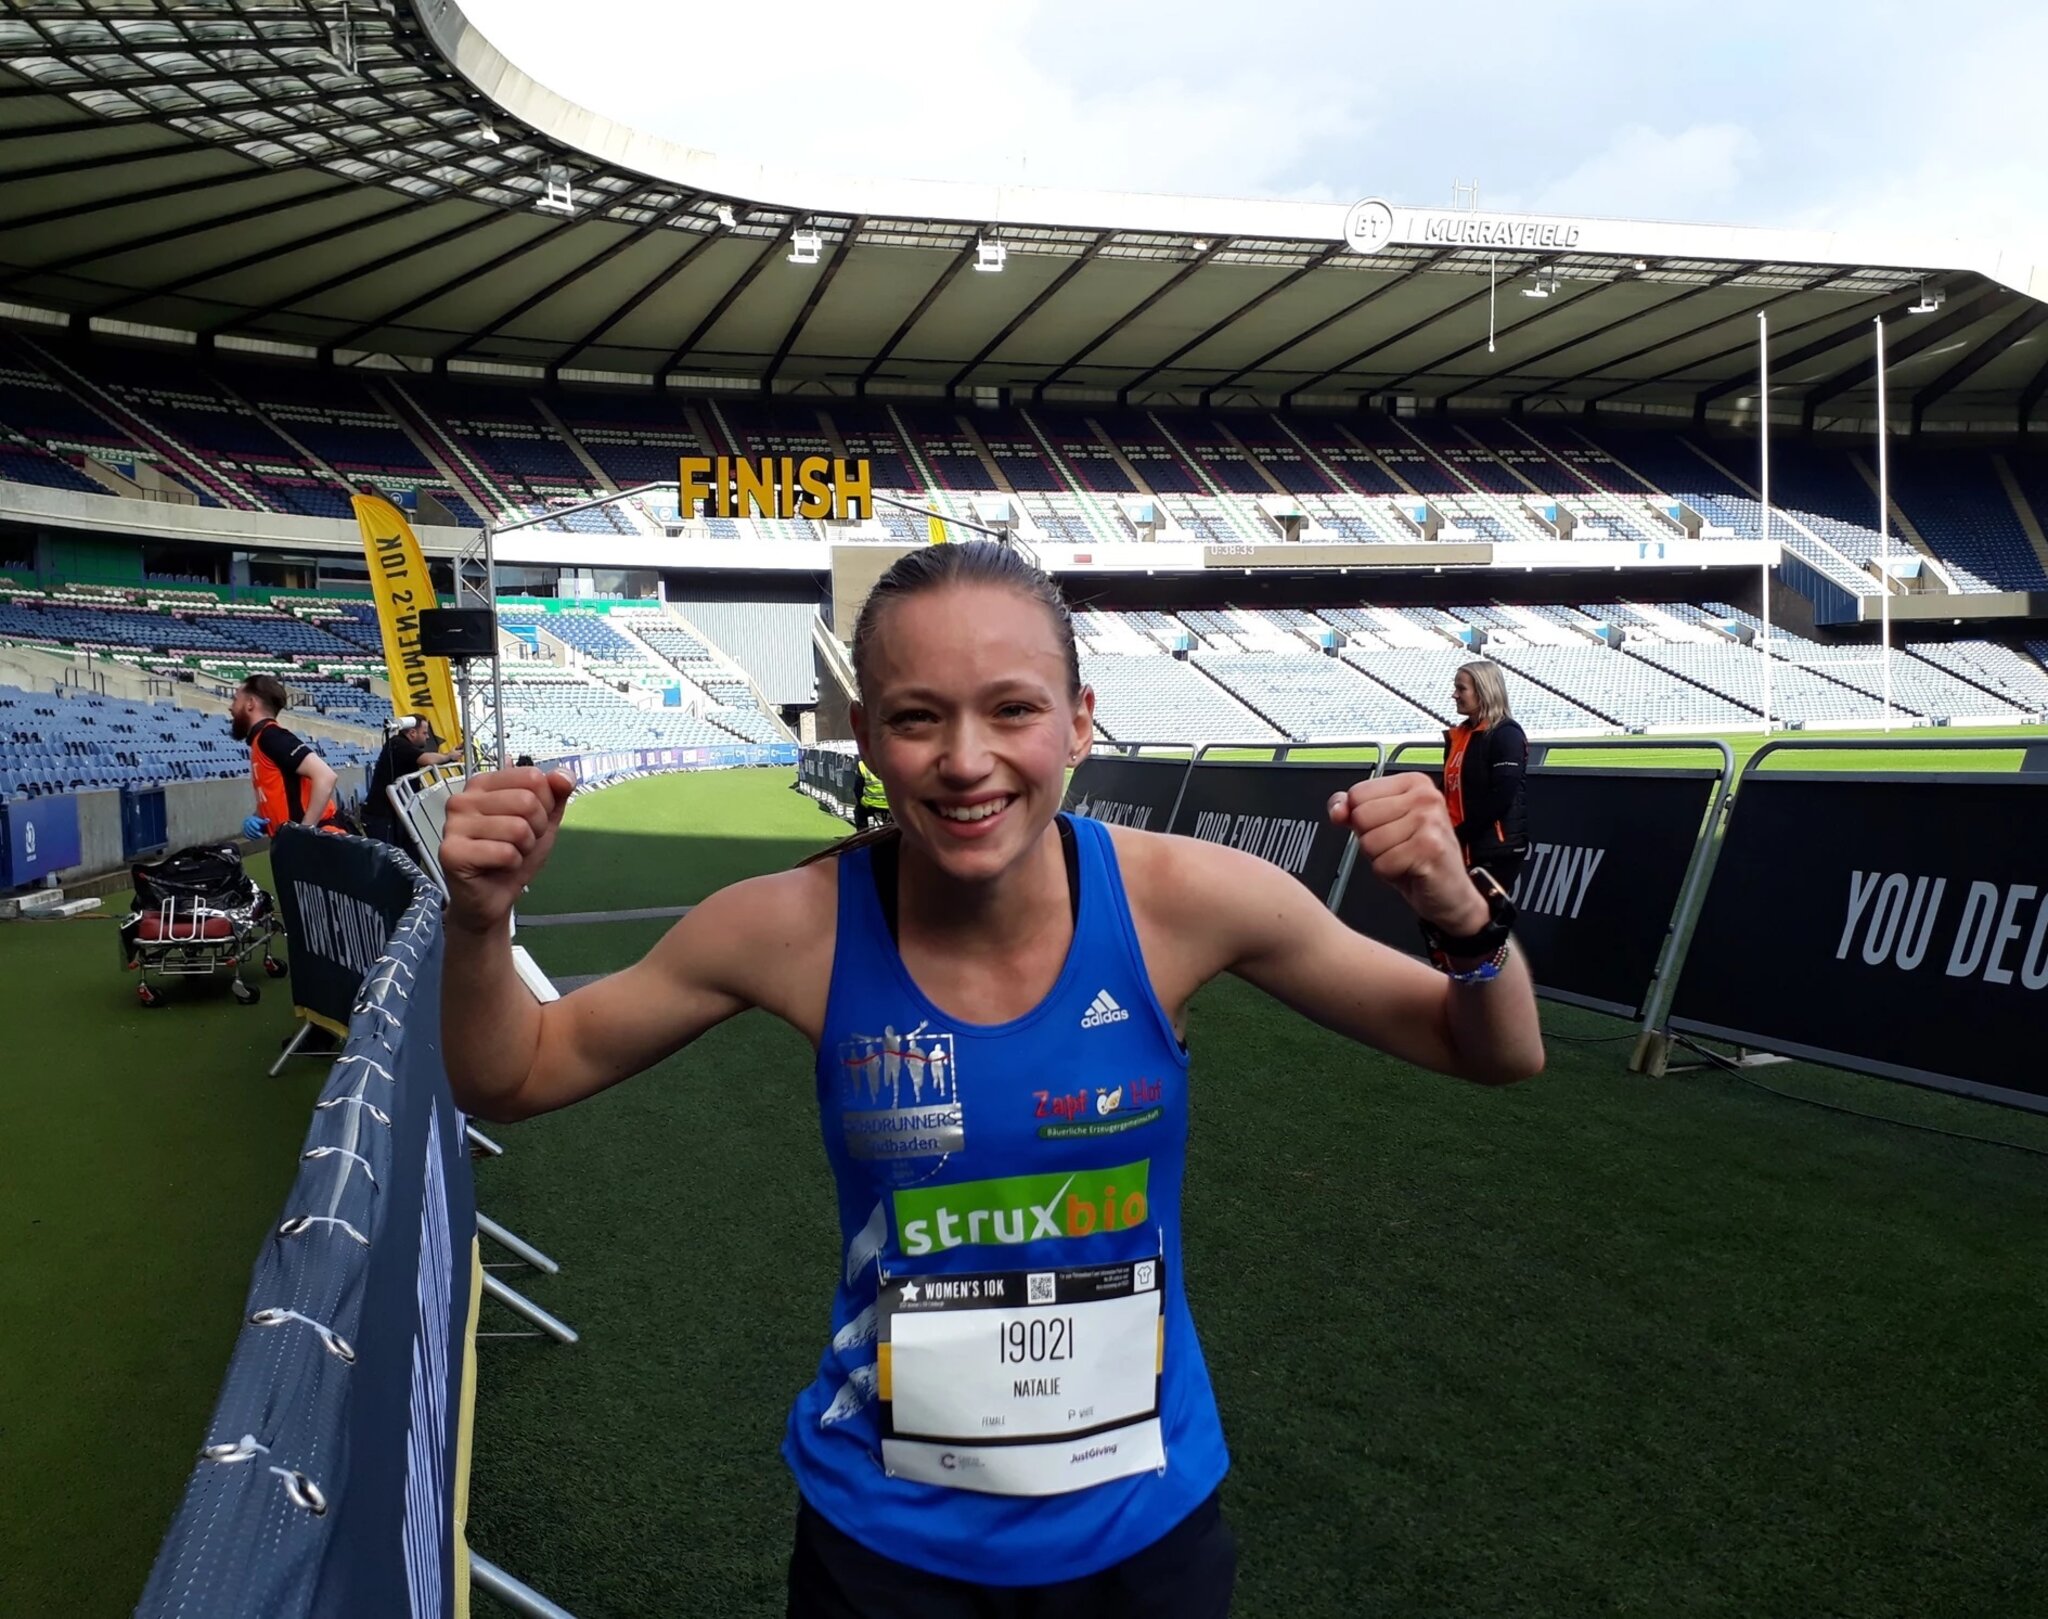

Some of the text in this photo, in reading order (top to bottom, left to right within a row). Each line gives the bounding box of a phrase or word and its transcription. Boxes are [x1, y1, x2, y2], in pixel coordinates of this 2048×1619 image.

[1354, 214, 1580, 247] BT MURRAYFIELD
[679, 456, 873, 519] FINISH
[1230, 815, 1319, 874] EVOLUTION
[294, 880, 335, 962] YOUR
[1835, 870, 1947, 971] YOU
[1081, 1009, 1129, 1028] adidas
[1032, 1089, 1087, 1121] Zapf
[1046, 1125, 1088, 1137] Bäuerliche
[904, 1174, 1146, 1256] struxbio
[925, 1279, 1005, 1300] WOMEN'S 10K
[1000, 1317, 1073, 1364] 19021
[1013, 1377, 1061, 1399] NATALIE
[1070, 1443, 1118, 1465] JustGiving
